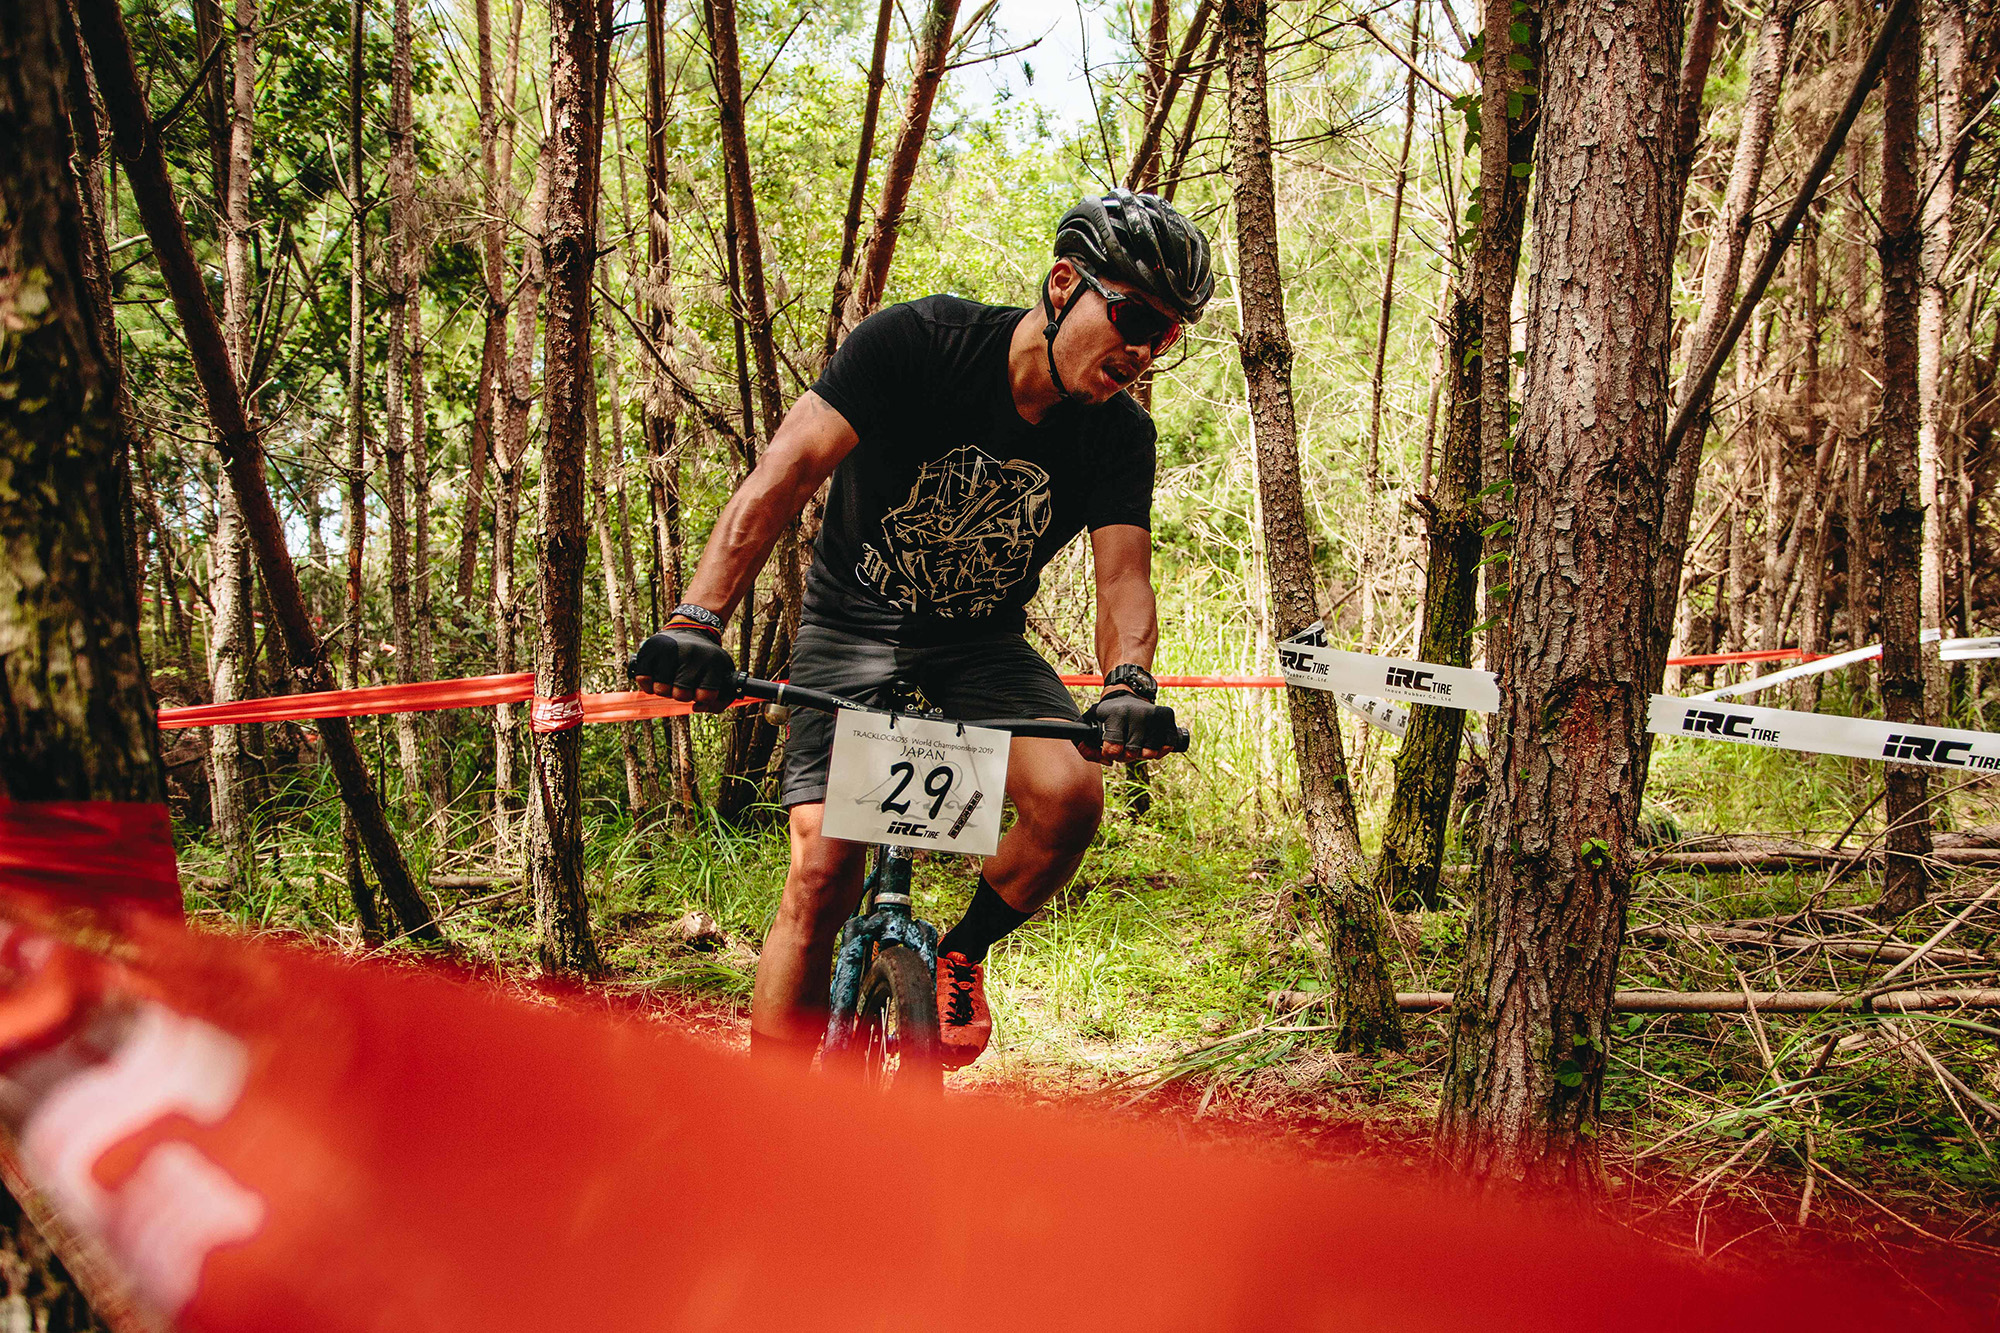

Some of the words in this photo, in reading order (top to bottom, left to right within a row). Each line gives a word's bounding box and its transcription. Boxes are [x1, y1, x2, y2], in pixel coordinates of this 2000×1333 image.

[1312, 662, 1330, 676] TIRE
[1386, 666, 1434, 692] iRC
[1432, 681, 1452, 695] TIRE
[831, 697, 868, 712] THOMS
[1404, 690, 1426, 698] Rubber
[1682, 709, 1754, 738] iRC
[1751, 727, 1780, 743] TIRE
[852, 730, 908, 744] TRACKLOCROSS
[912, 738, 932, 746] World
[933, 740, 977, 754] Championship
[978, 746, 994, 754] 2019
[1882, 734, 1974, 766] iRC
[900, 745, 946, 761] JAPAN
[881, 761, 954, 820] 29
[886, 821, 928, 837] iRC
[924, 830, 941, 840] TIRE
